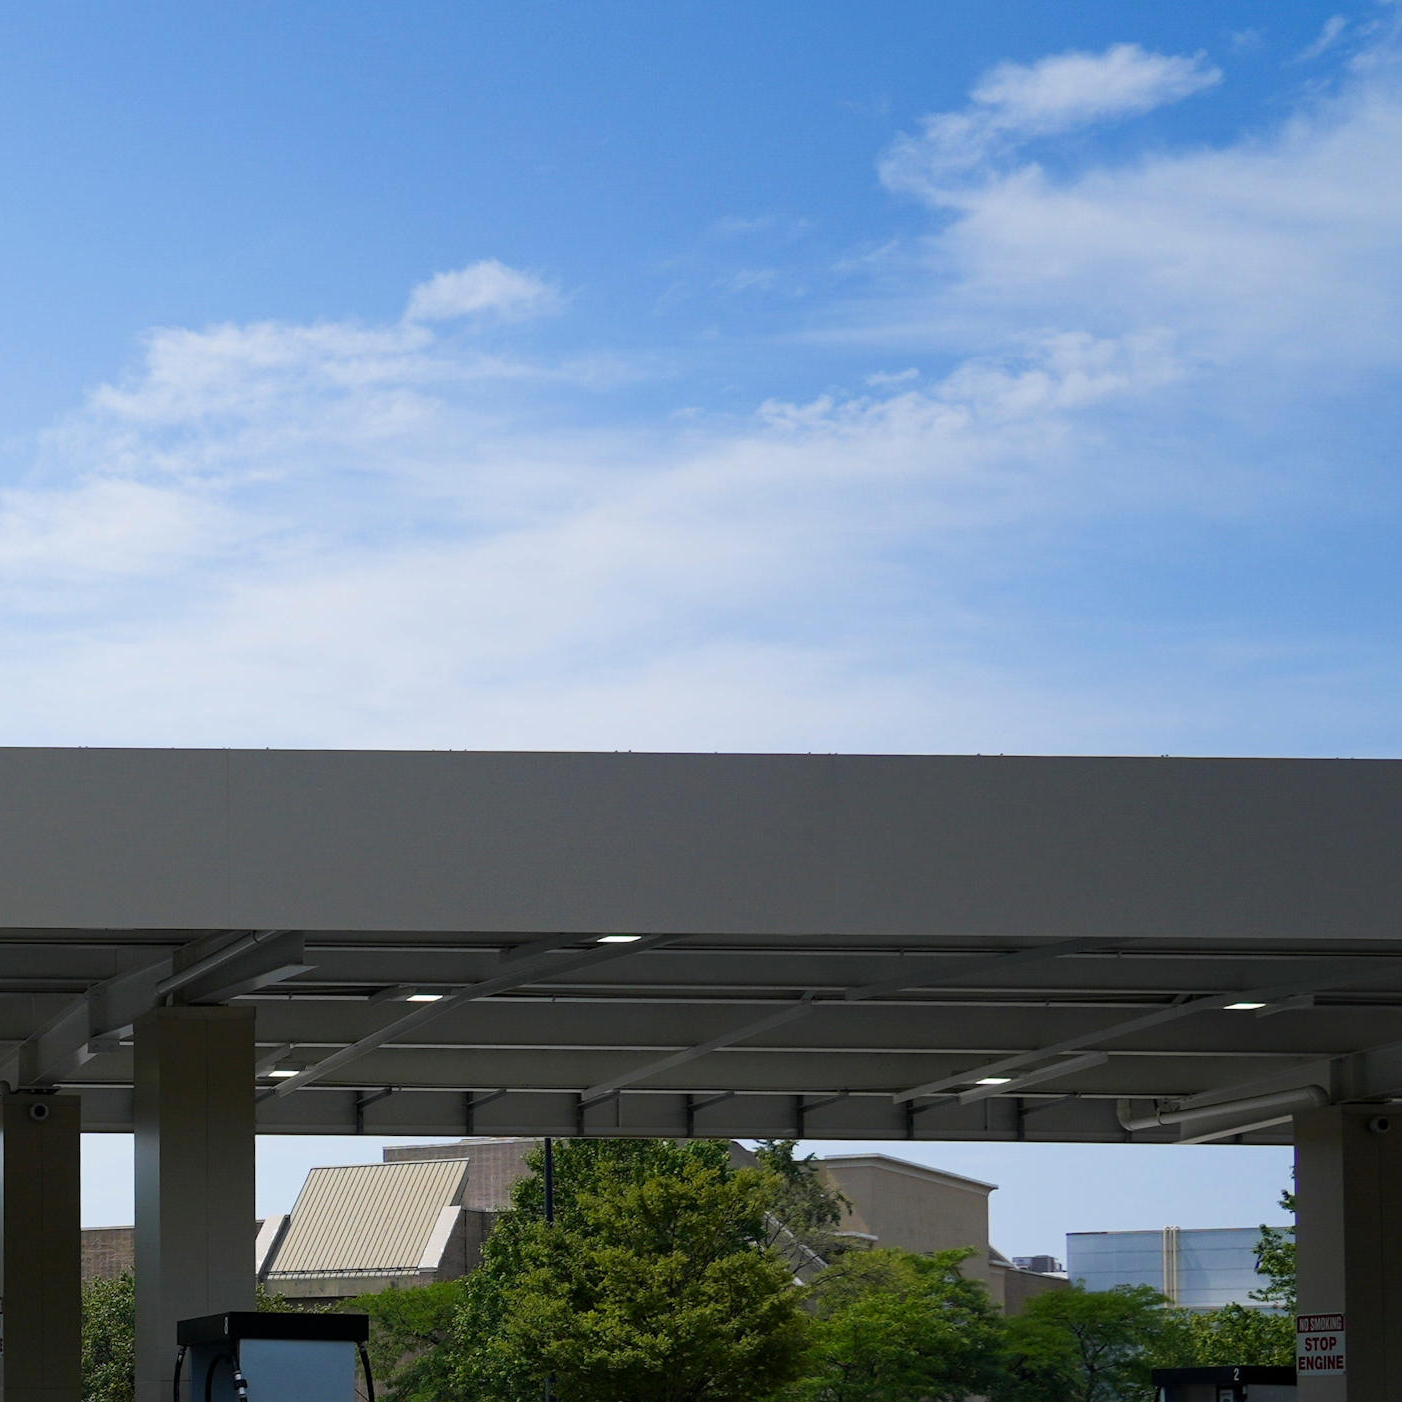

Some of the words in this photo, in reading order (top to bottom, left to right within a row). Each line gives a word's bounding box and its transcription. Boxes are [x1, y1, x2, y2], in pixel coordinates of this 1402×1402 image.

[1299, 1318, 1308, 1331] NO
[1310, 1316, 1342, 1331] SMOKING
[1305, 1337, 1336, 1351] STOP
[1298, 1356, 1344, 1370] ENGINE
[1233, 1367, 1240, 1381] 2
